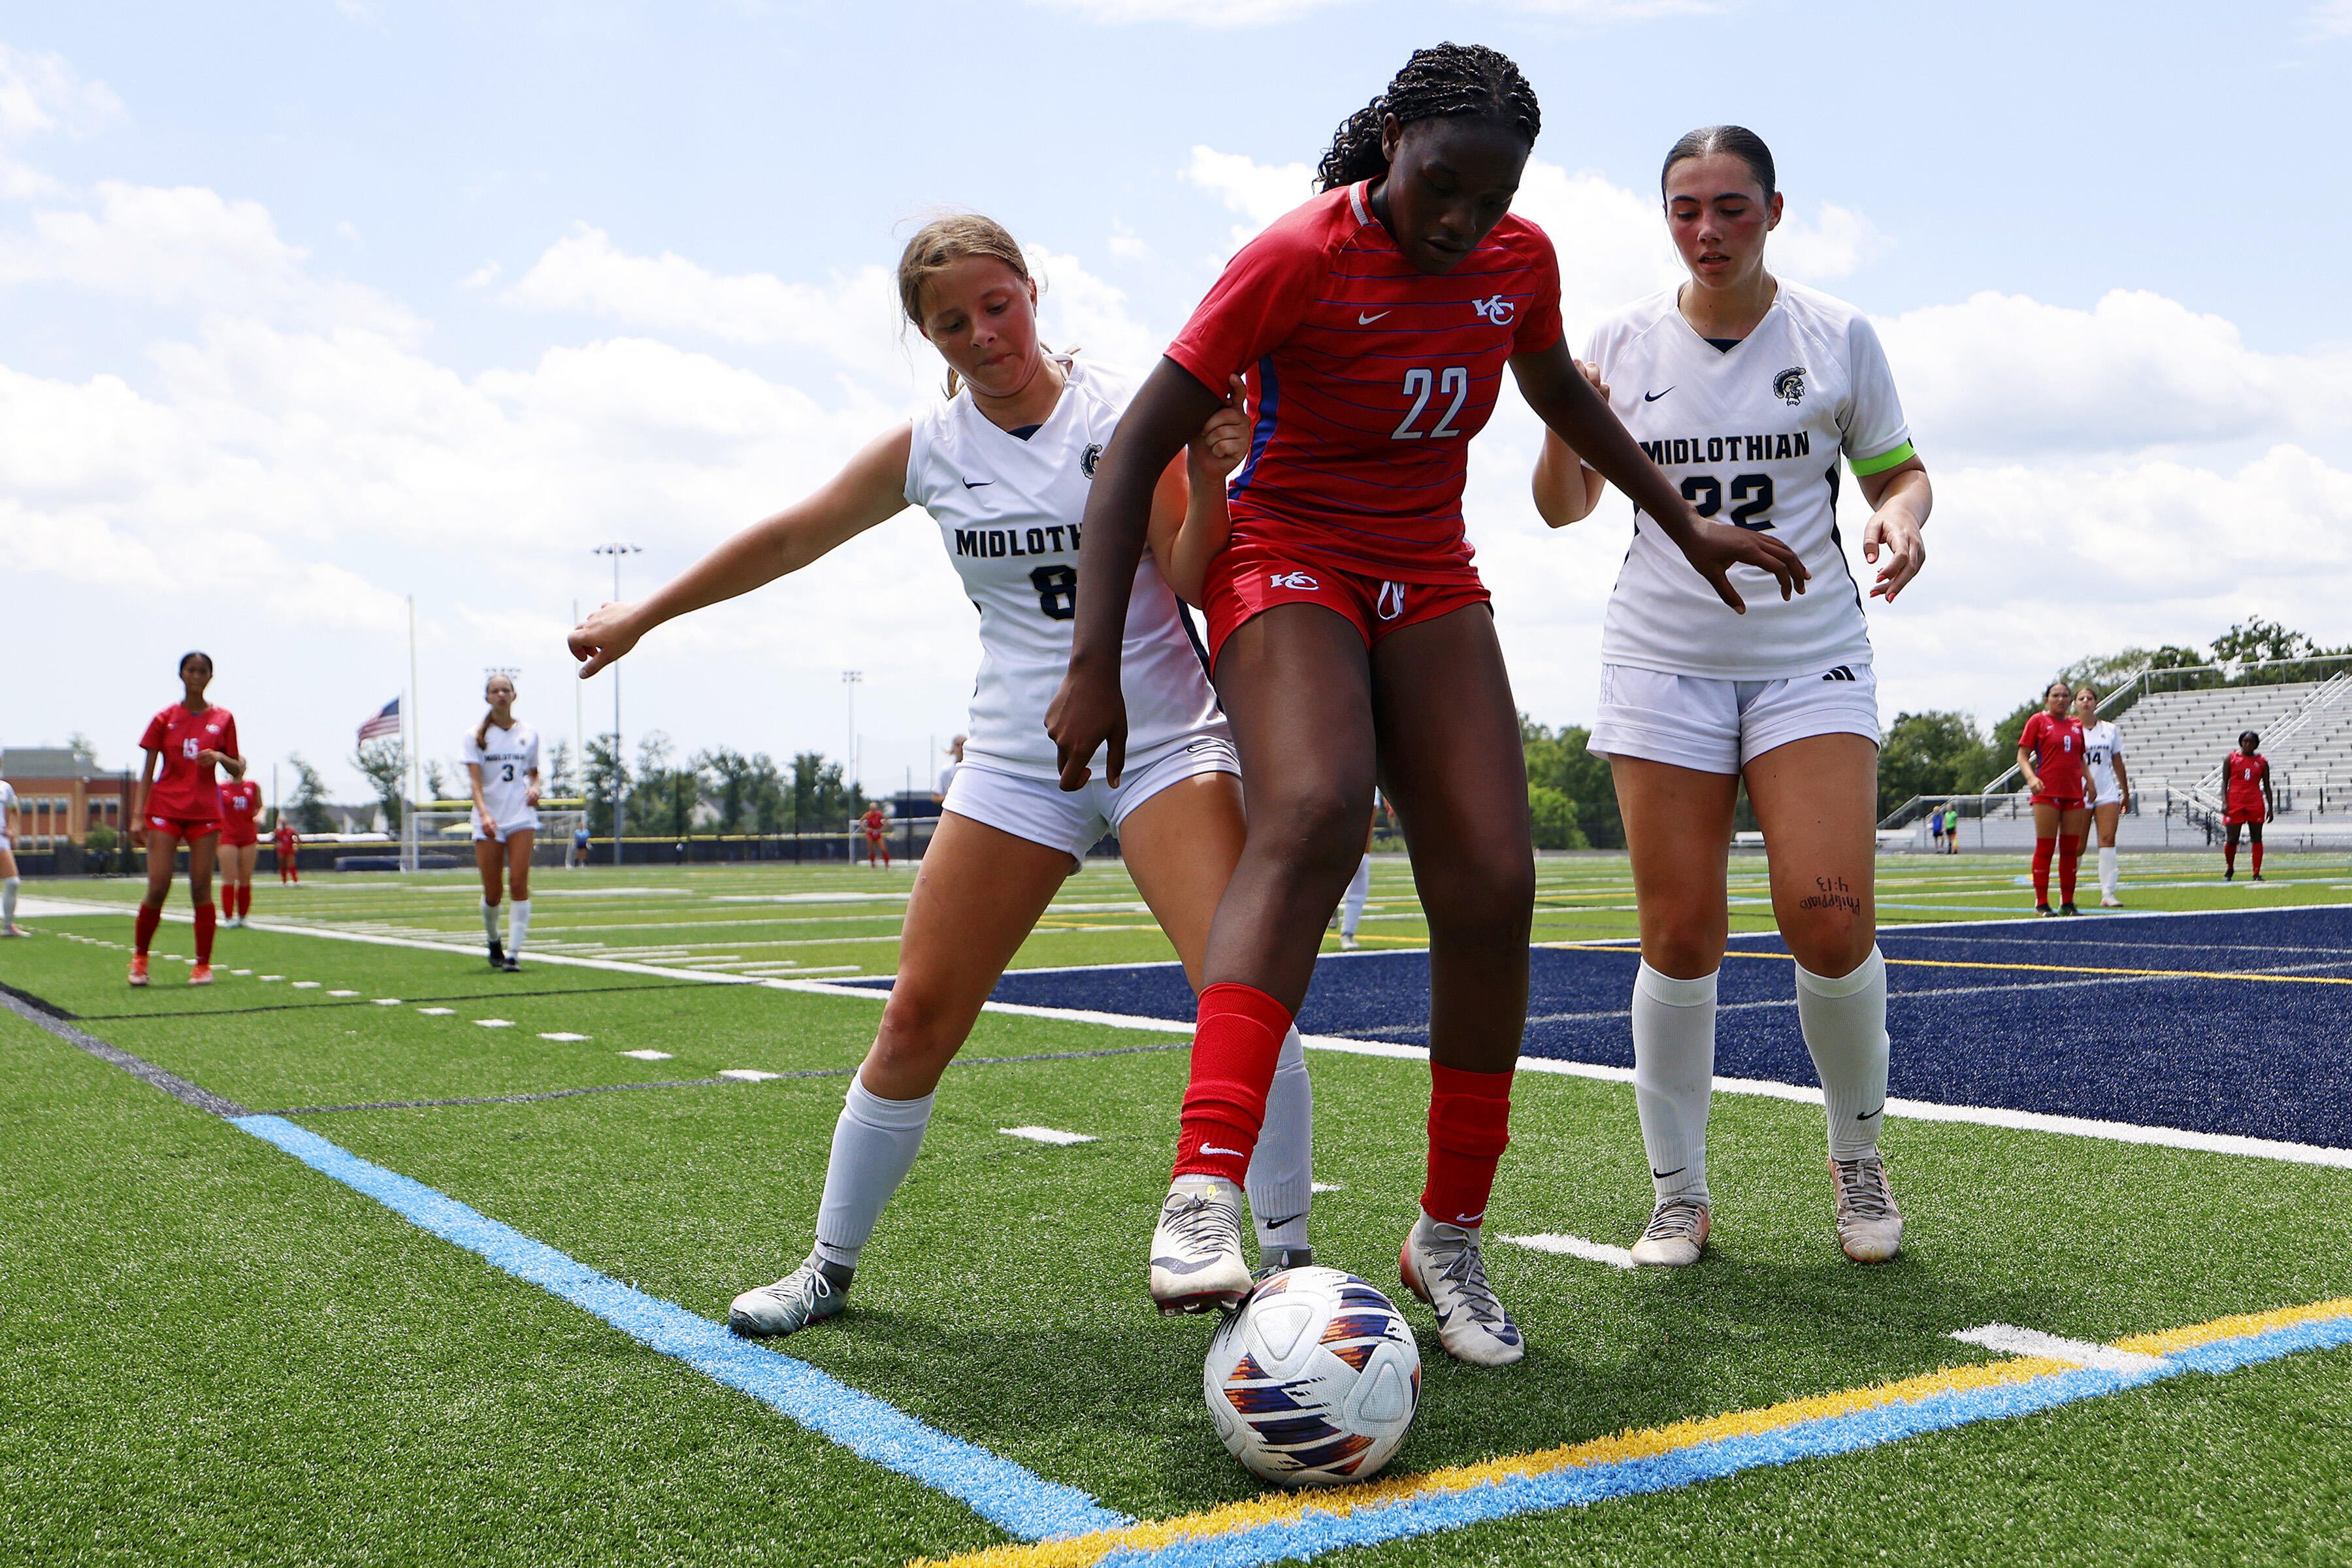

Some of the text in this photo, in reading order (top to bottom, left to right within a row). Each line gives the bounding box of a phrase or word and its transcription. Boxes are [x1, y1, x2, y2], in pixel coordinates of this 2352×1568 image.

[1471, 295, 1514, 325] KC
[1390, 366, 1468, 440] 22
[1639, 431, 1810, 465] MIDLOTHIAN
[1680, 472, 1778, 532] 22
[1028, 563, 1077, 622] 8
[183, 738, 199, 760] 15
[2063, 735, 2072, 752] 9
[2086, 751, 2102, 765] 14
[502, 763, 514, 782] 3
[1816, 876, 1848, 892] 4:13
